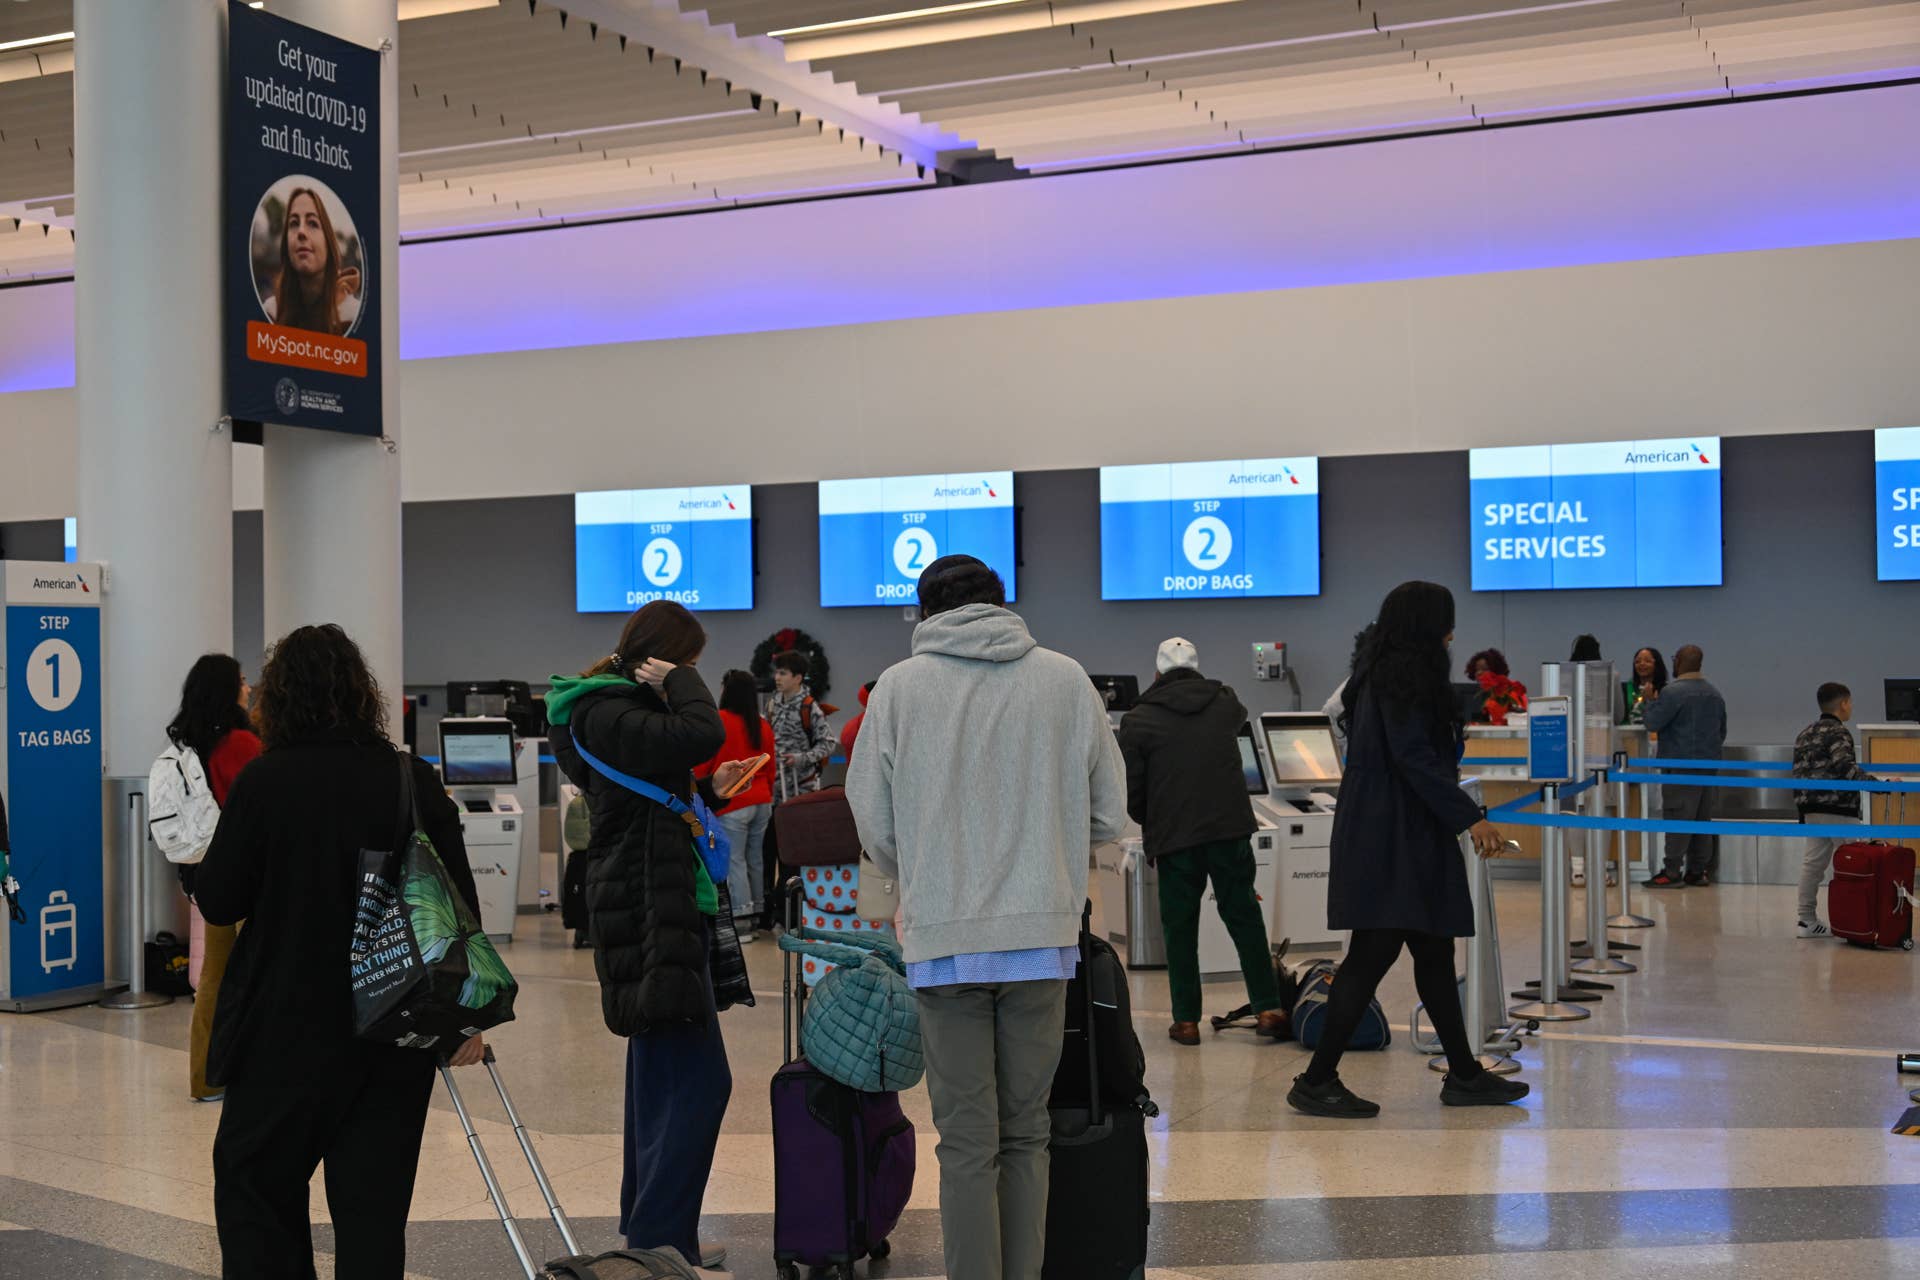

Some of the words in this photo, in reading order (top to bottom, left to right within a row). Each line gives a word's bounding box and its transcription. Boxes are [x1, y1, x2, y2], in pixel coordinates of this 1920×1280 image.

[278, 40, 302, 72] Get
[305, 53, 337, 83] your
[245, 76, 304, 115] updated
[306, 92, 366, 133] COVID-19
[262, 125, 289, 153] and
[292, 128, 312, 159] flu
[314, 136, 352, 171] shots.
[257, 332, 358, 365] MySpot.nc.gov
[1624, 451, 1689, 464] American
[1228, 473, 1282, 484] American
[934, 486, 981, 498] American
[679, 498, 722, 510] American
[1194, 500, 1220, 512] STEP
[902, 512, 926, 524] STEP
[1484, 501, 1588, 526] SPECIAL
[650, 524, 672, 534] STEP
[1198, 528, 1216, 560] 2
[1484, 535, 1606, 560] SERVICES
[906, 538, 924, 569] 2
[654, 548, 670, 578] 2
[33, 578, 76, 590] American
[1164, 576, 1208, 591] DROP
[1212, 574, 1254, 590] BAGS
[626, 590, 662, 604] DROP
[665, 590, 700, 604] BAGS
[876, 584, 916, 598] DROP
[40, 615, 70, 630] STEP
[45, 653, 60, 698] 1
[18, 730, 49, 748] TAG
[53, 728, 91, 746] BAGS
[389, 930, 406, 943] THE
[372, 942, 410, 964] THING
[366, 971, 385, 984] EVER
